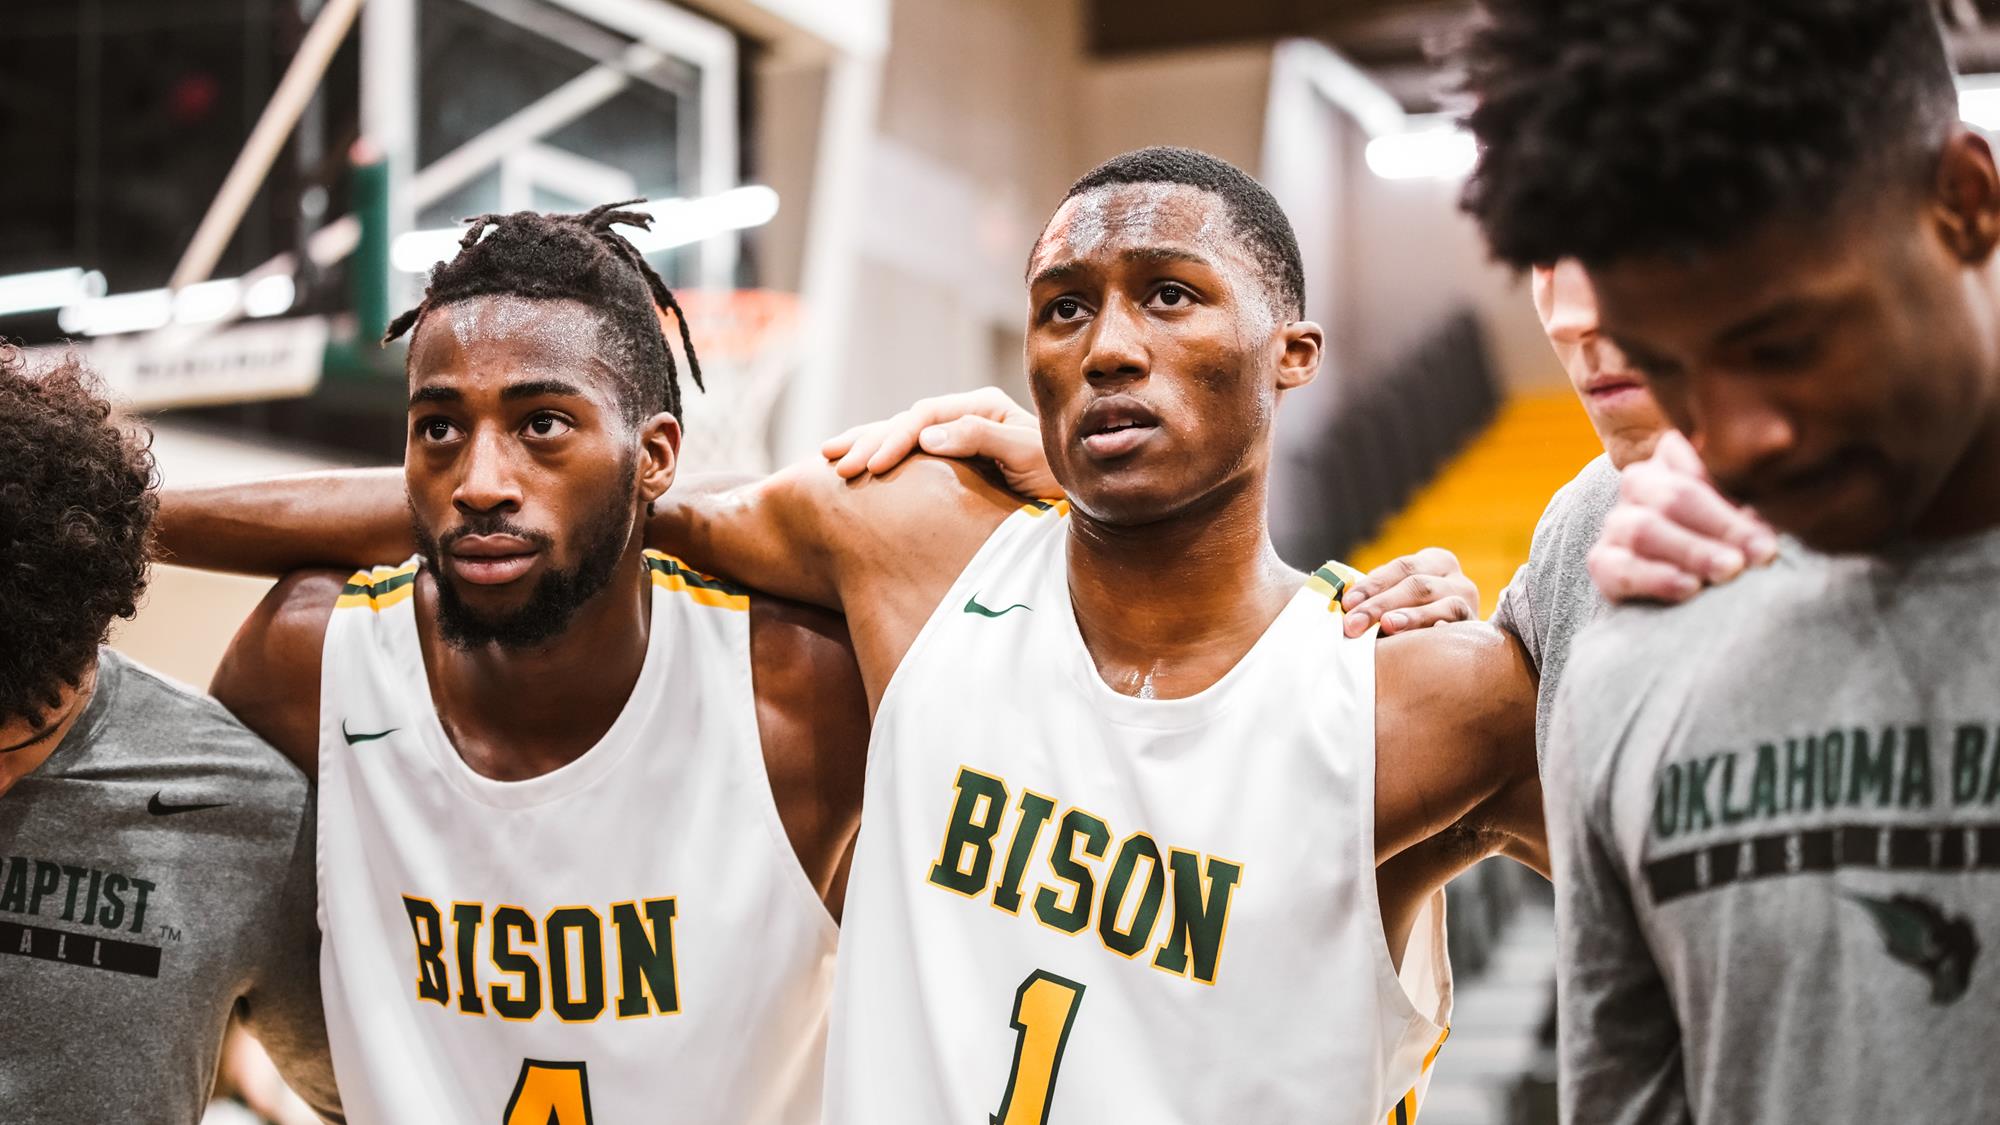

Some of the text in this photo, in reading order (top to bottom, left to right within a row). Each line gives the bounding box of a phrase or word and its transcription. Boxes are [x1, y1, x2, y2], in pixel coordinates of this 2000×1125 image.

[1654, 724, 1933, 840] OKLAHOMA
[0, 855, 156, 934] APTIST
[926, 764, 1244, 986] BISON
[19, 928, 101, 967] ALL
[401, 893, 681, 1024] BISON
[988, 968, 1087, 1125] 1
